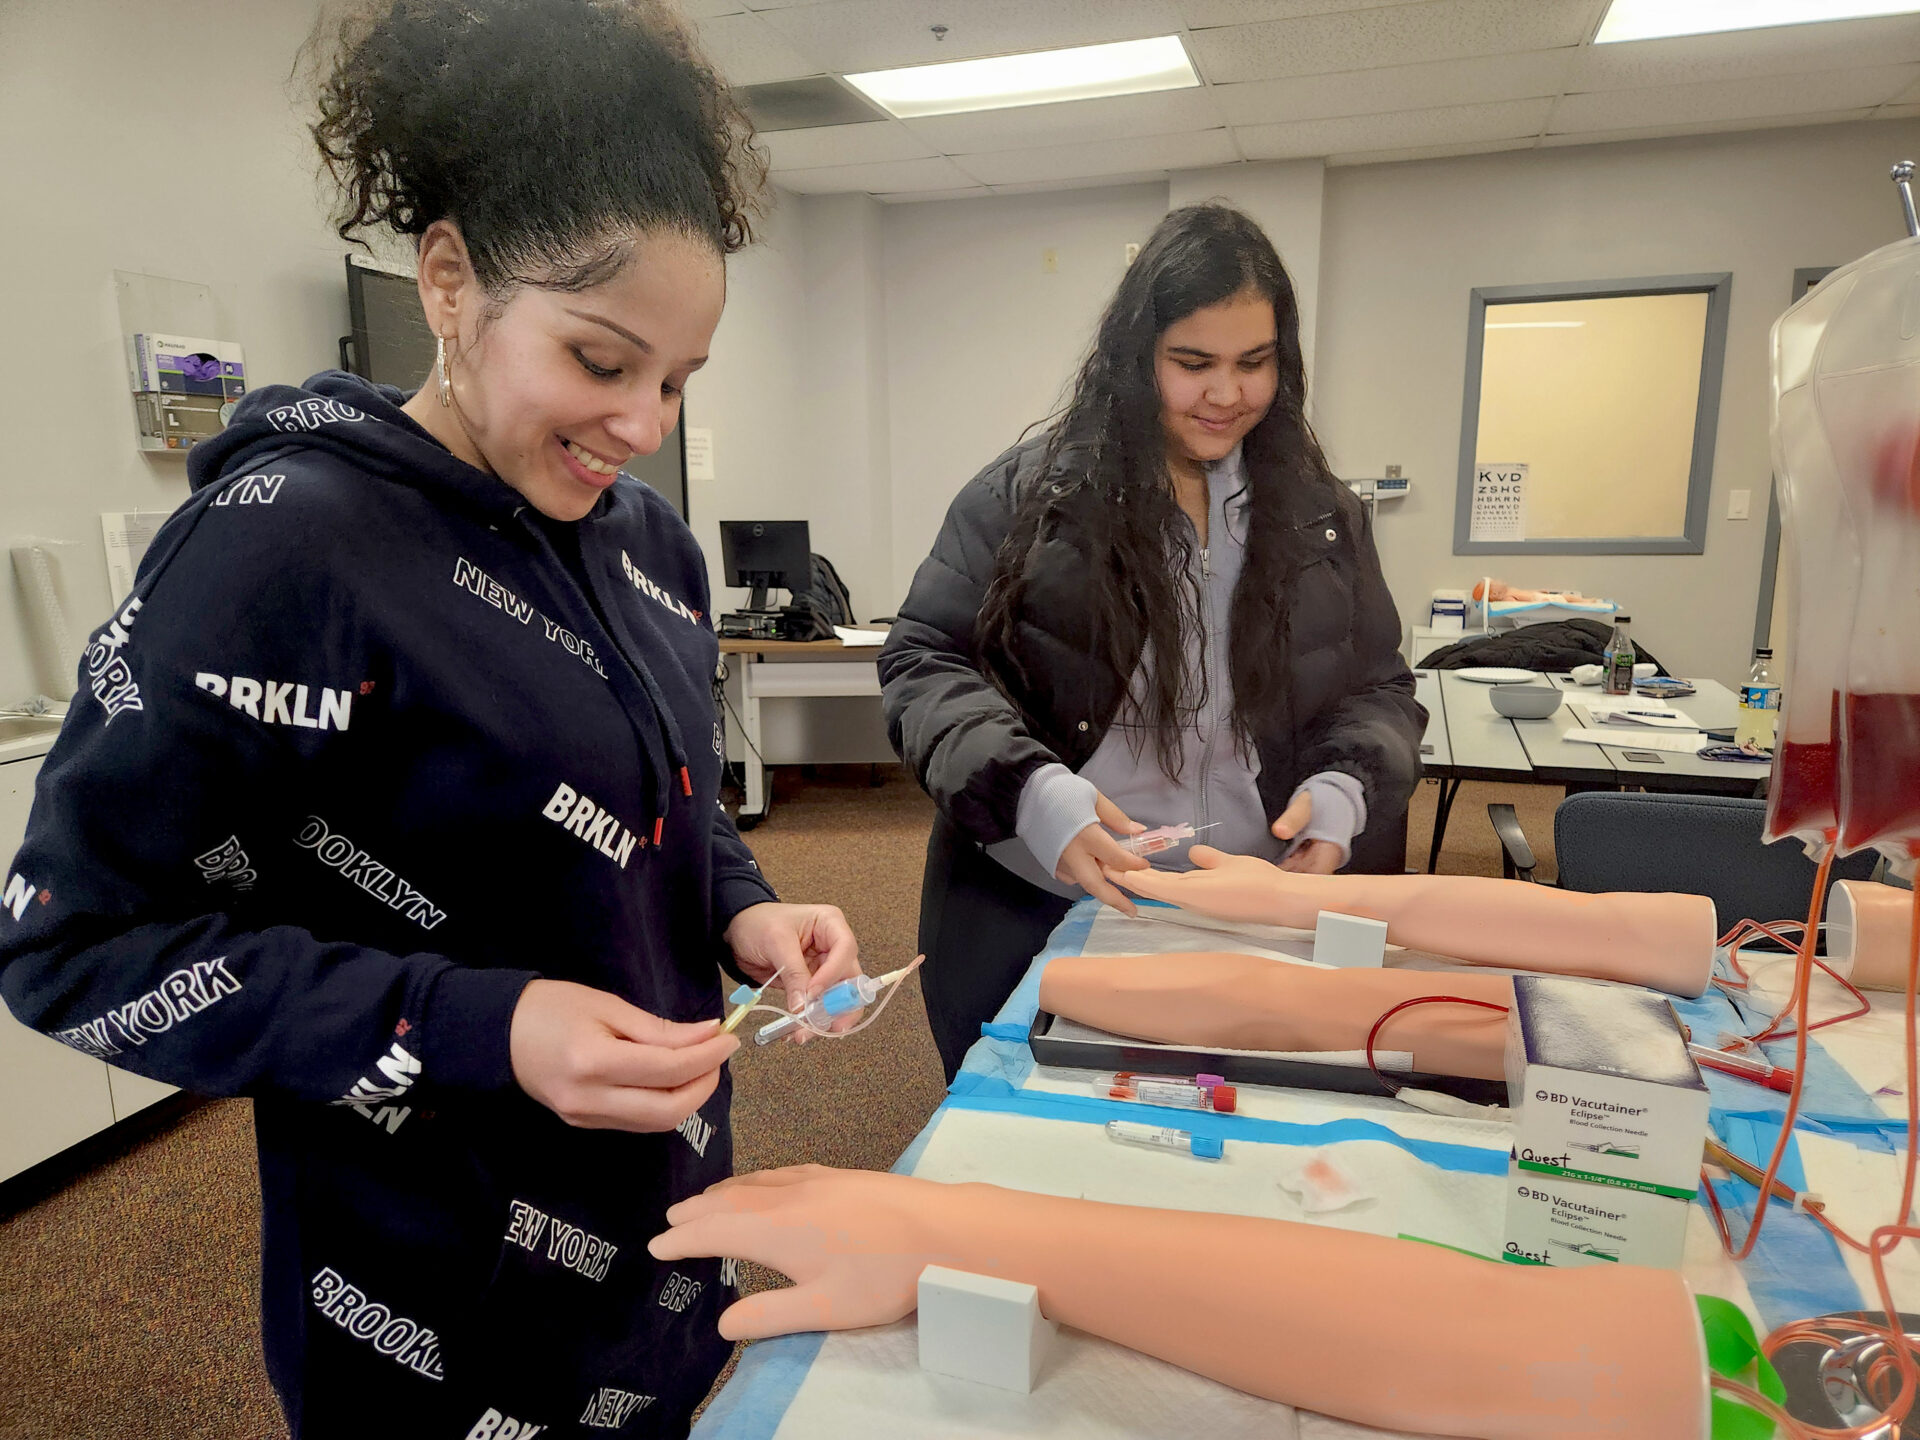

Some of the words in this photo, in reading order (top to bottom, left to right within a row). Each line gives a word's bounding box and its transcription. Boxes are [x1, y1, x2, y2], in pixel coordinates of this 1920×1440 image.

[266, 397, 382, 433] BRO
[210, 474, 286, 507] YN
[452, 556, 534, 625] NEW
[621, 549, 698, 626] BRKLN
[84, 641, 144, 728] ORK
[541, 781, 638, 870] BRKLN
[106, 956, 243, 1046] YORK
[1550, 1092, 1569, 1104] BD
[1569, 1119, 1589, 1128] Blood
[1590, 1122, 1623, 1134] Collection
[1624, 1128, 1649, 1137] Needle
[1521, 1148, 1572, 1169] Quest
[1531, 1190, 1549, 1202] BD
[1550, 1217, 1570, 1227] Blood
[1570, 1222, 1603, 1236] Collection
[1604, 1231, 1628, 1242] Needle
[546, 1217, 618, 1282] YORK
[1505, 1241, 1552, 1264] Quest
